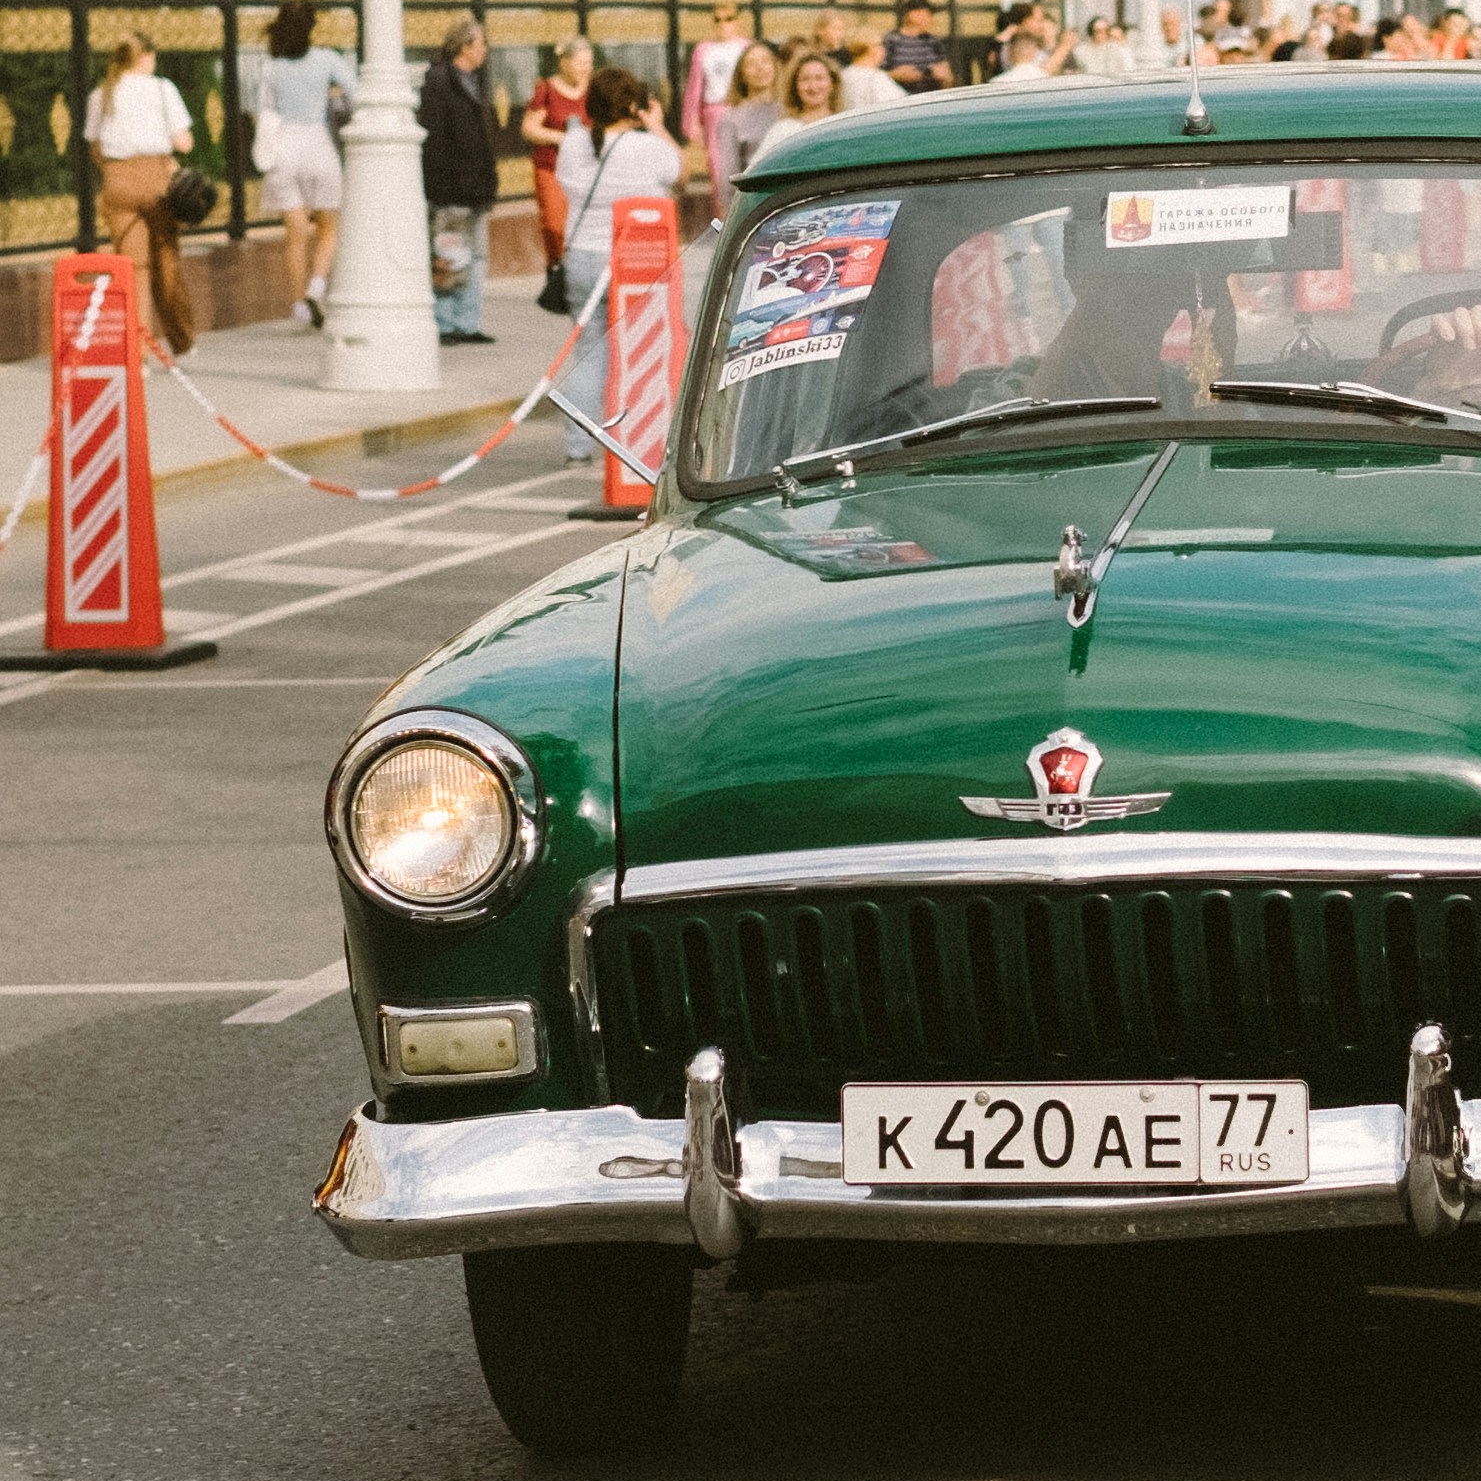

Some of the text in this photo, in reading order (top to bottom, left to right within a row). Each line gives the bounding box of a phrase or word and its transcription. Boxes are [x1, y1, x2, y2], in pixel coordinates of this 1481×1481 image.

[1221, 205, 1285, 217] ОСОБОГО
[1159, 218, 1252, 232] НАЗНАЧЕНИЯ
[1209, 1094, 1277, 1147] 77
[1220, 1153, 1272, 1172] RUS
